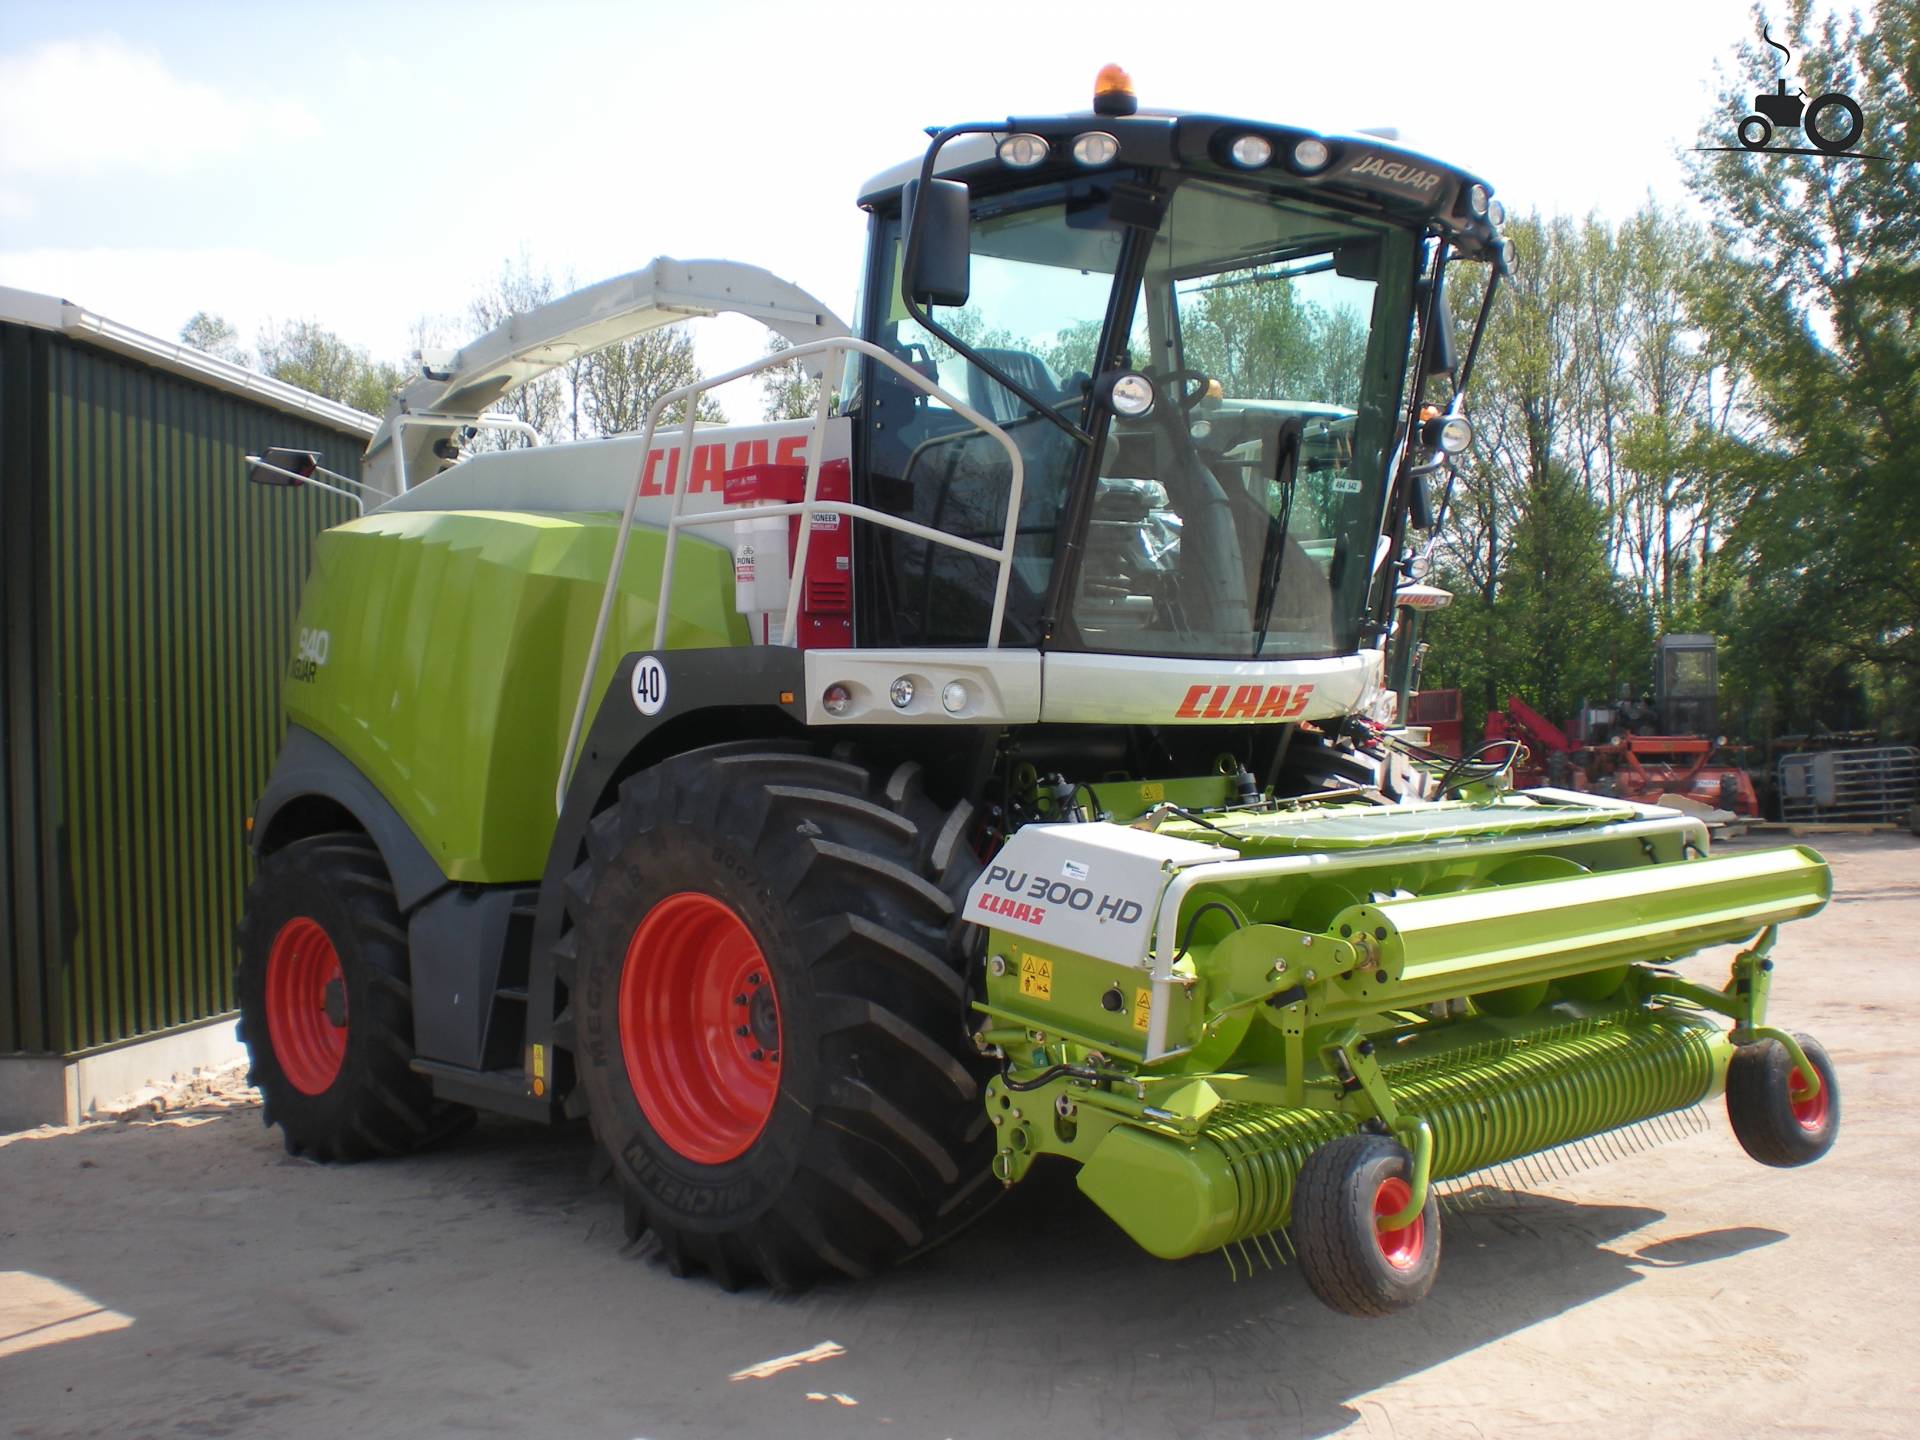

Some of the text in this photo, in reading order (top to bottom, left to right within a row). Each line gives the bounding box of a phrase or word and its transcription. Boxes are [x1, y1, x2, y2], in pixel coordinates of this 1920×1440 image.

[1351, 156, 1441, 191] JAGUAR
[811, 513, 837, 523] IONEER
[637, 666, 660, 703] 40
[1174, 684, 1315, 718] CLAAS
[978, 893, 1046, 925] CLAAS
[984, 865, 1143, 924] PU 300 HD
